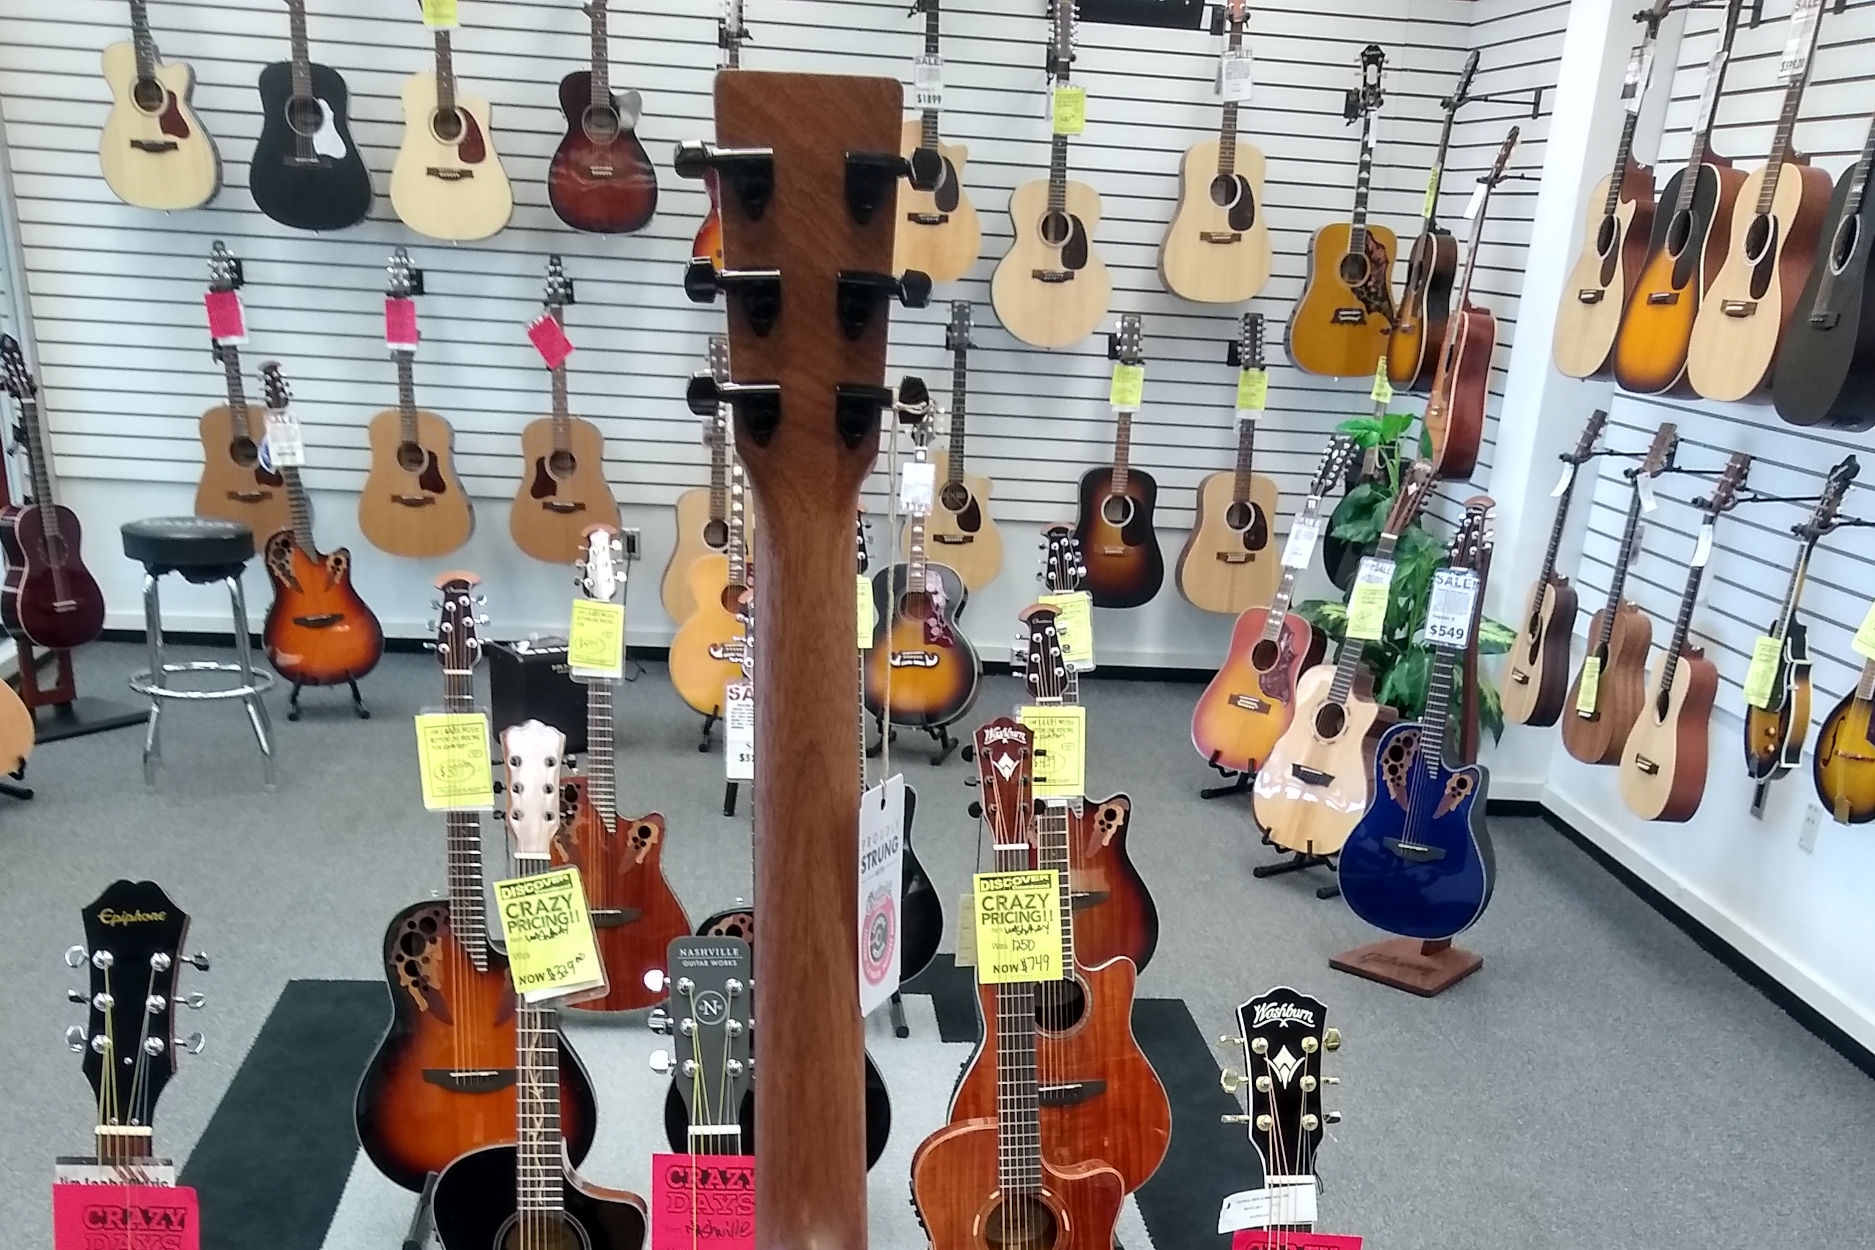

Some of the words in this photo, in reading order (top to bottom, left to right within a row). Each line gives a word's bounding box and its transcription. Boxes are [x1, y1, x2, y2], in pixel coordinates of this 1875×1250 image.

[1430, 624, 1464, 639] $549
[728, 686, 753, 701] SA
[984, 727, 1026, 743] Washburn
[861, 835, 899, 874] STRUNG
[505, 893, 573, 919] CRAZY
[981, 893, 1050, 911] CRAZY
[97, 908, 167, 927] Epiphone
[680, 948, 740, 957] NASHVILLE
[993, 964, 1019, 974] NOW
[1020, 954, 1050, 973] $749
[519, 972, 546, 985] NOW
[1253, 1002, 1314, 1024] Washburn
[667, 1191, 755, 1216] DAYS
[83, 1204, 187, 1232] CRAZY
